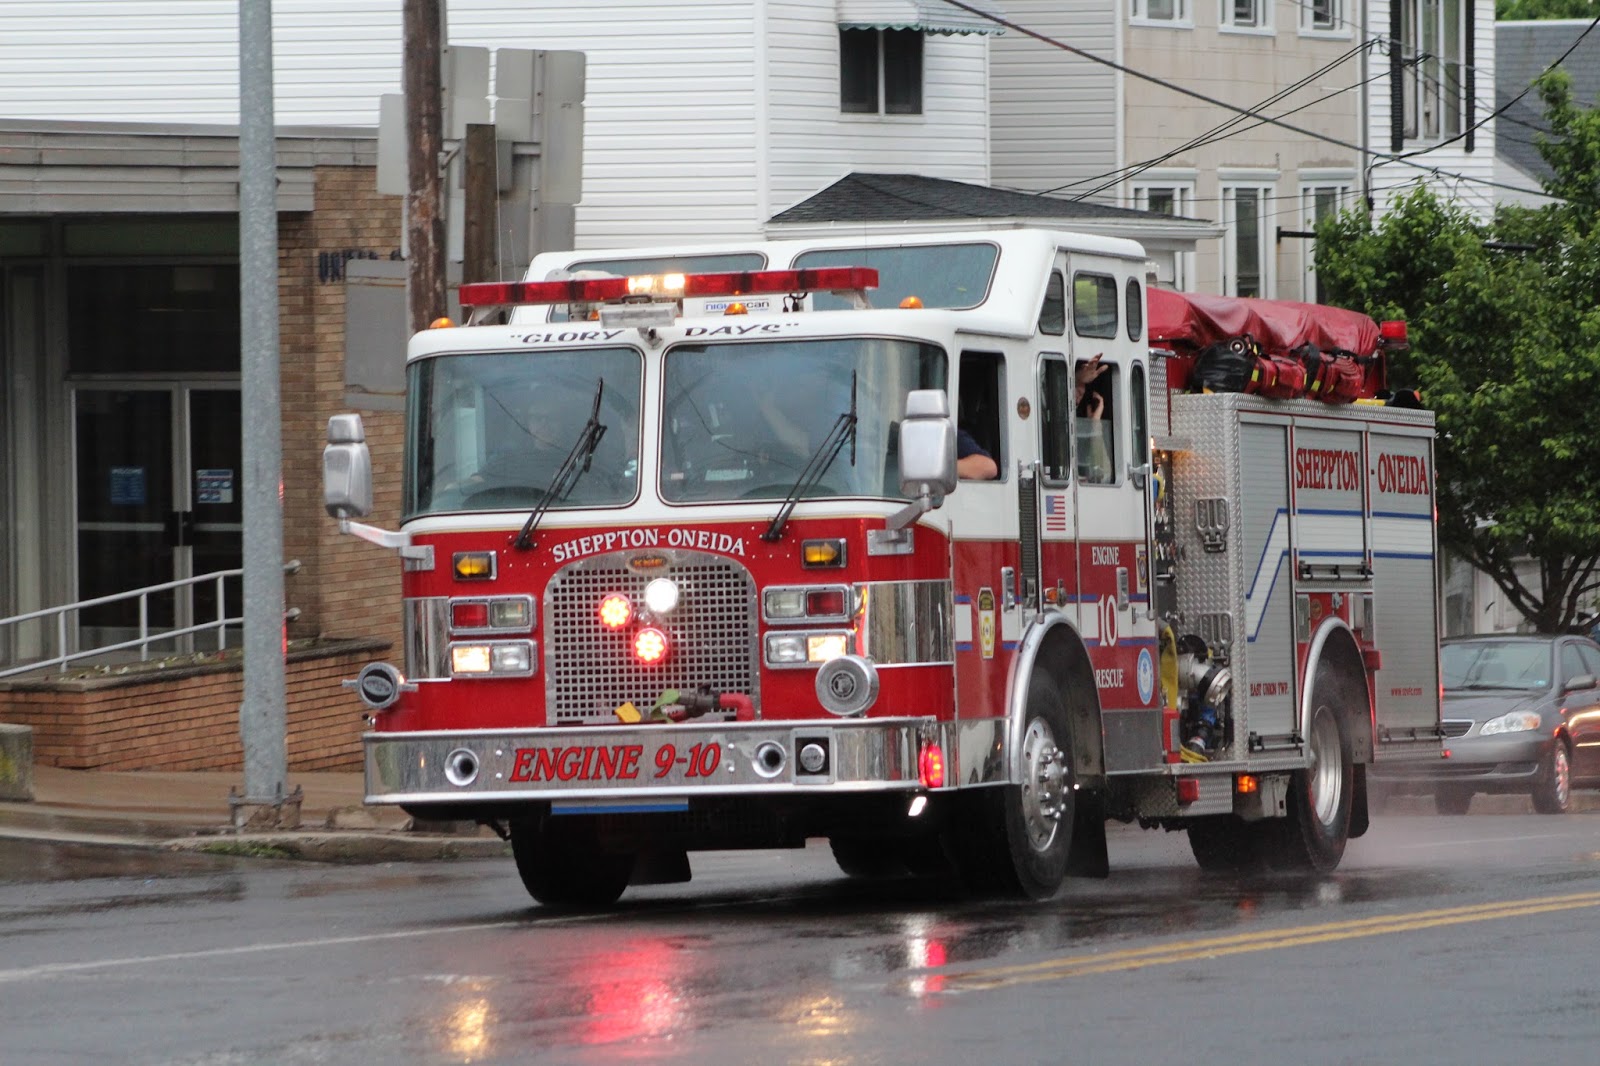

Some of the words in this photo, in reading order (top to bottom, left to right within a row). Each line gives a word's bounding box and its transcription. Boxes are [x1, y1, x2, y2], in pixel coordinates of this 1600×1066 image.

[1296, 447, 1360, 491] SHEPPTON
[1377, 453, 1429, 495] ONEIDA
[552, 528, 746, 563] SHEPPTON-ONEIDA
[1092, 546, 1120, 566] ENGINE
[1098, 594, 1119, 647] 10
[1095, 668, 1124, 689] RESCUE
[1250, 683, 1262, 697] EAST
[1263, 682, 1277, 696] UNION
[508, 744, 643, 783] ENGINE
[653, 742, 722, 779] 9-10
